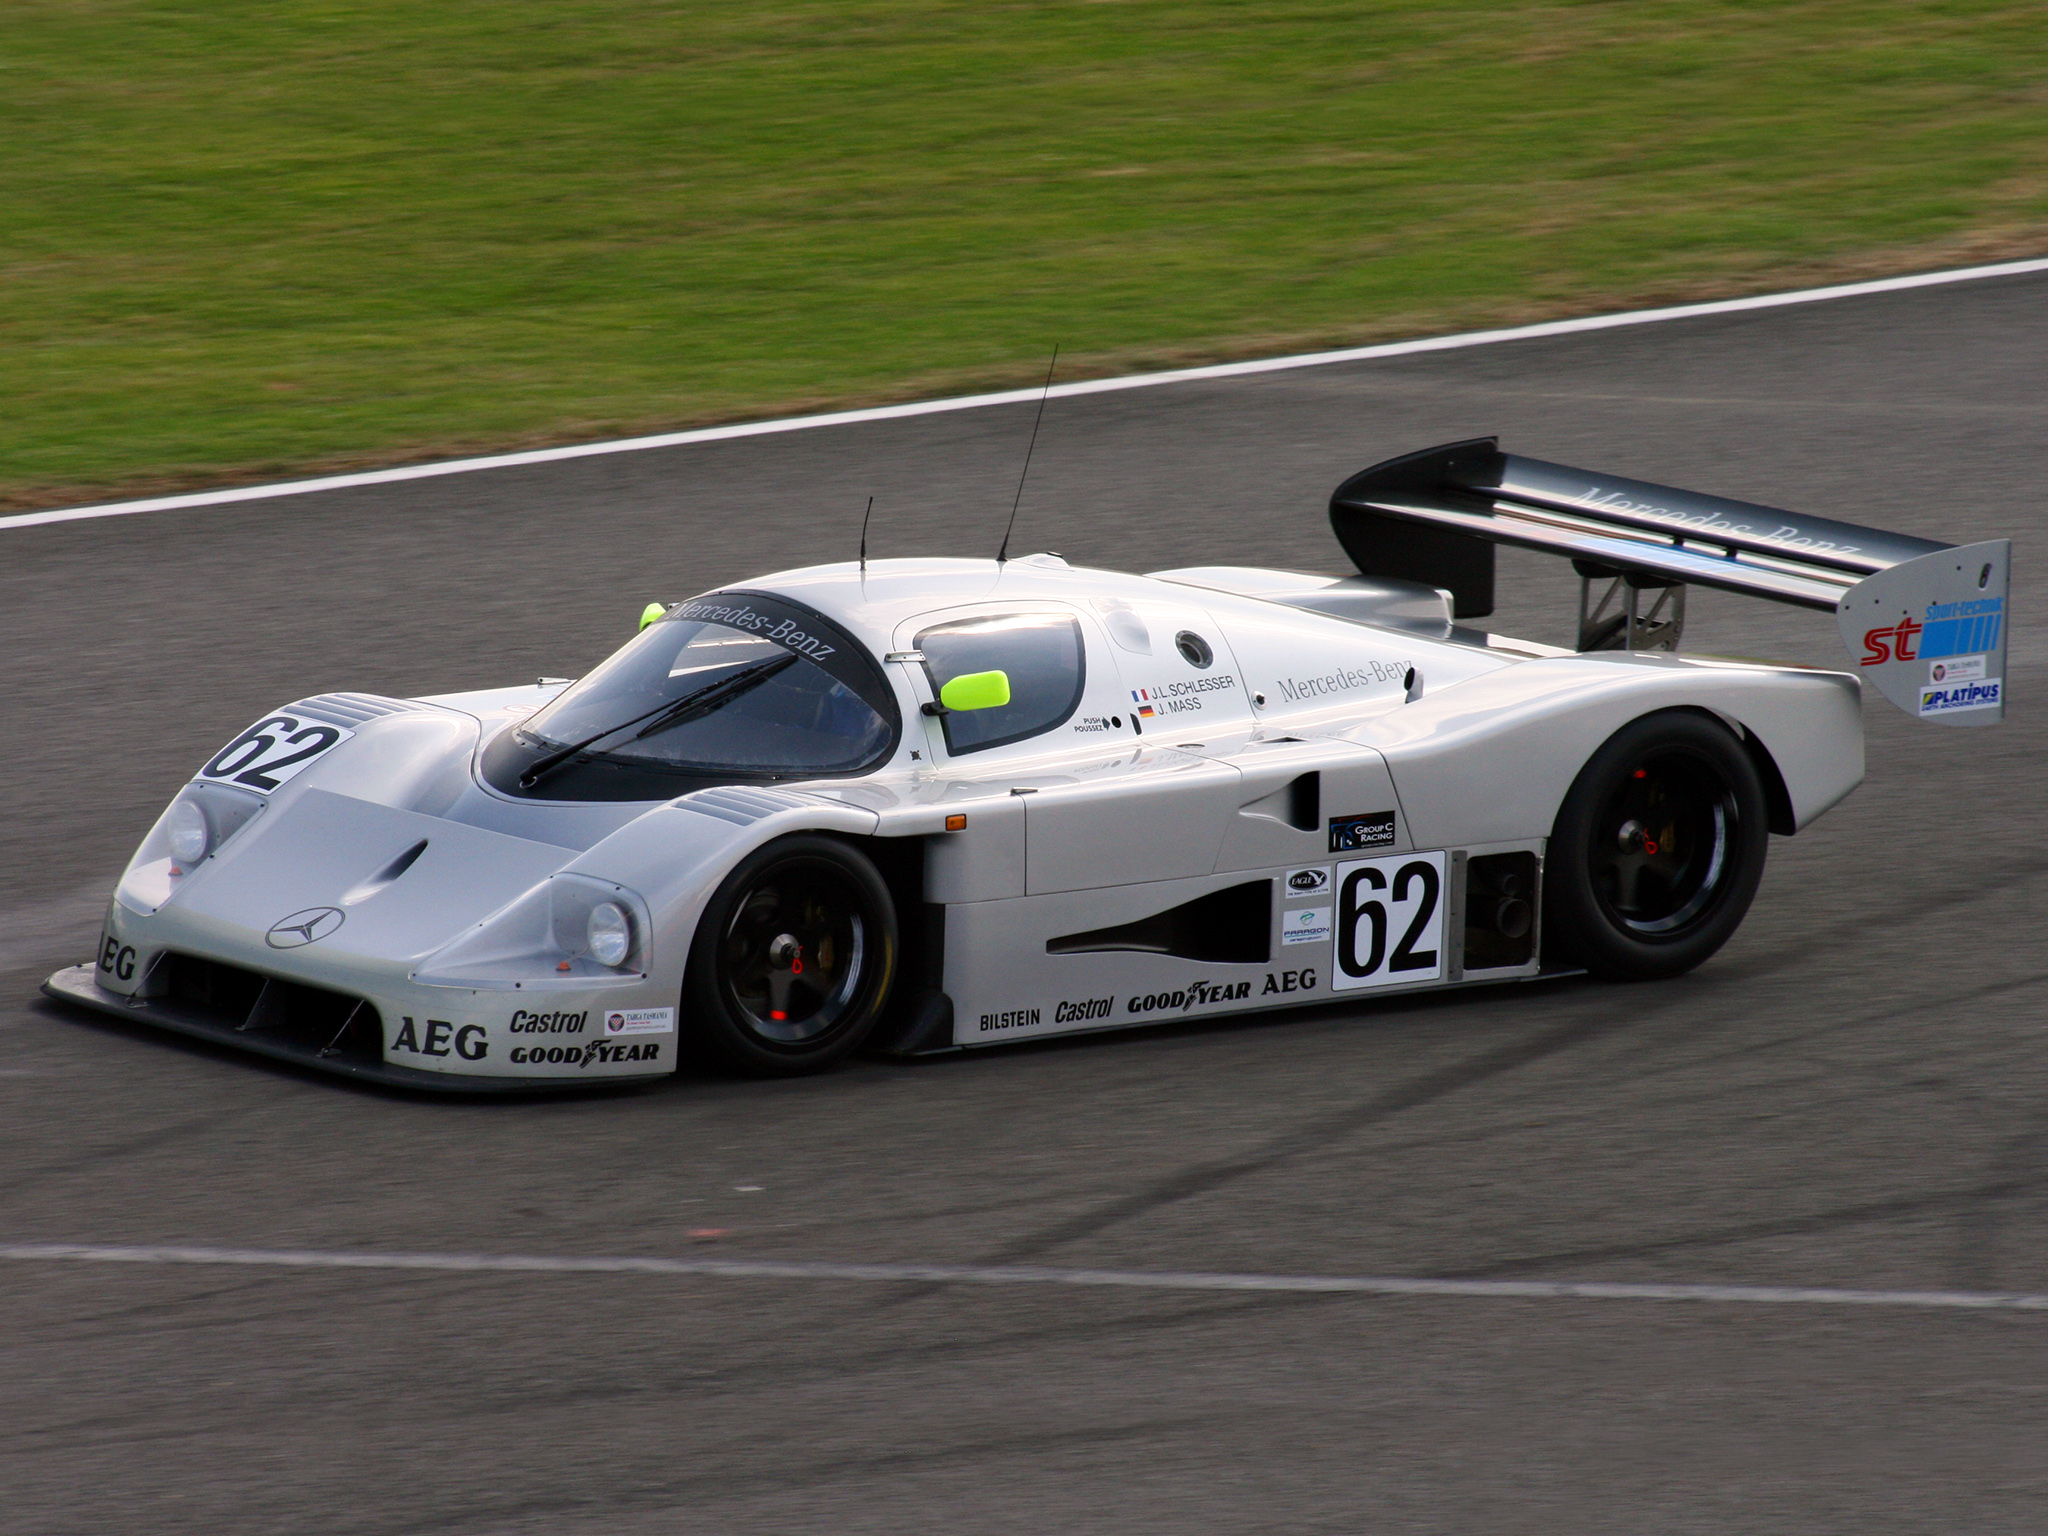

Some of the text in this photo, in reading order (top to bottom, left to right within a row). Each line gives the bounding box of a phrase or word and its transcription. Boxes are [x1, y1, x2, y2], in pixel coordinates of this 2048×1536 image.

[667, 602, 836, 662] Mercedes-Benz
[1151, 675, 1236, 700] J.L.SCHLESSER
[1168, 697, 1202, 713] MASS
[202, 716, 340, 791] 62
[1355, 822, 1394, 835] GROUP C
[1360, 832, 1393, 843] RACING
[1291, 876, 1312, 886] EAGLE
[1338, 860, 1440, 979] 62
[1284, 927, 1330, 937] PARAGON
[1261, 968, 1317, 996] AEG
[509, 1010, 589, 1034] Castrol
[979, 1008, 1041, 1032] BILSTEIN
[1054, 996, 1114, 1024] Castrol
[390, 1016, 489, 1061] AEG
